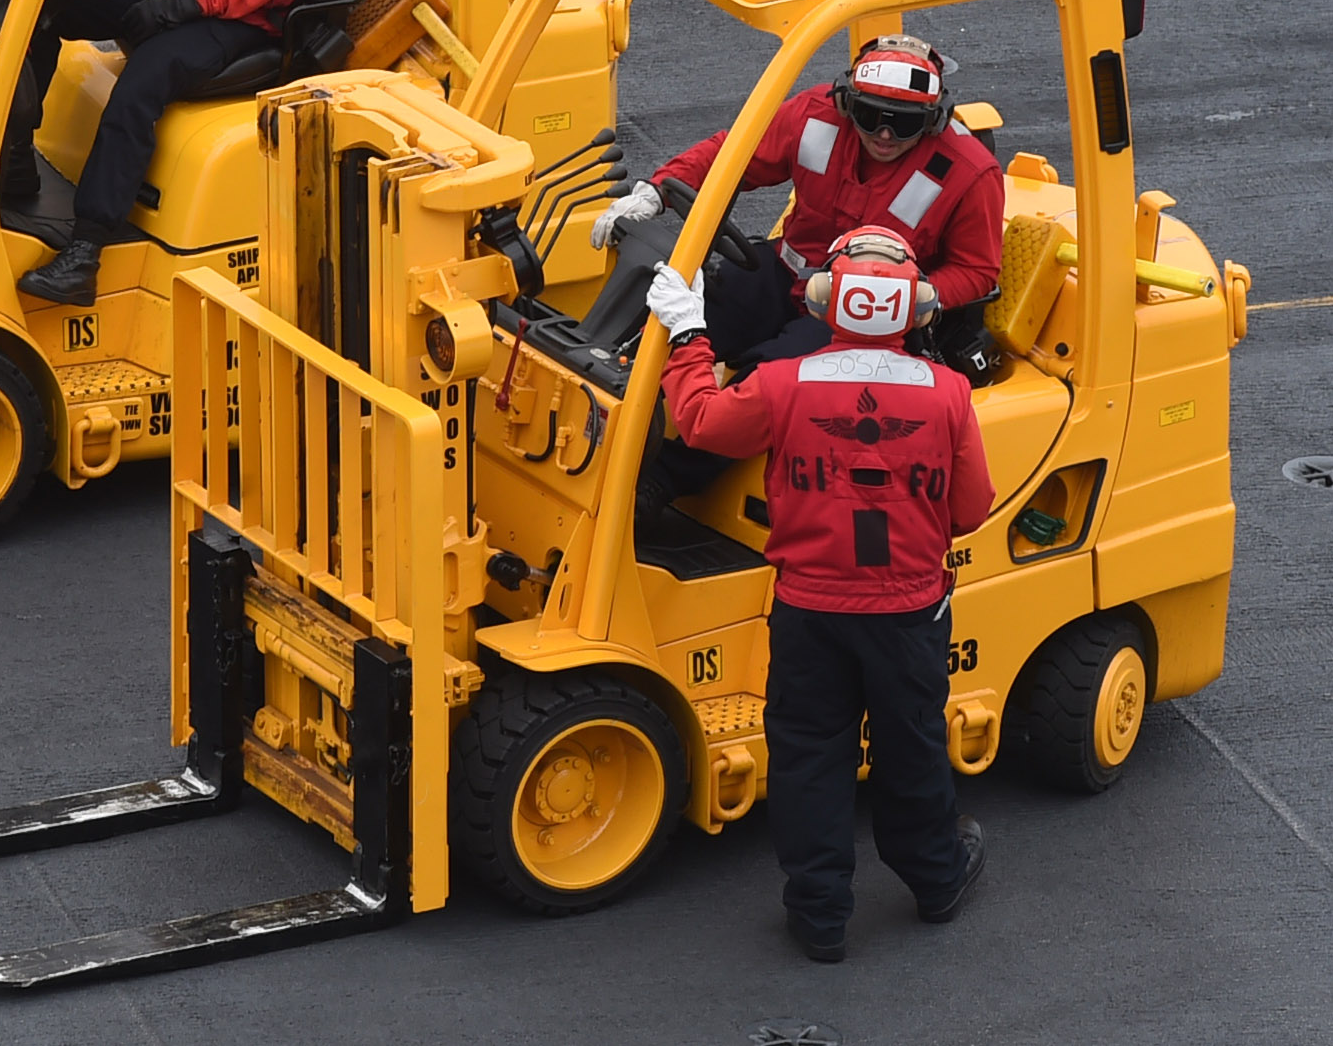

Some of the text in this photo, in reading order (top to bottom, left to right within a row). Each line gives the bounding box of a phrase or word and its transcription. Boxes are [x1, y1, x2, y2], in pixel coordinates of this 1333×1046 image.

[860, 63, 883, 78] G-1
[842, 286, 902, 322] G-1
[68, 316, 94, 348] DS
[821, 353, 892, 378] SOSA
[124, 404, 139, 416] TIE
[946, 547, 973, 570] USE
[692, 647, 719, 684] DS
